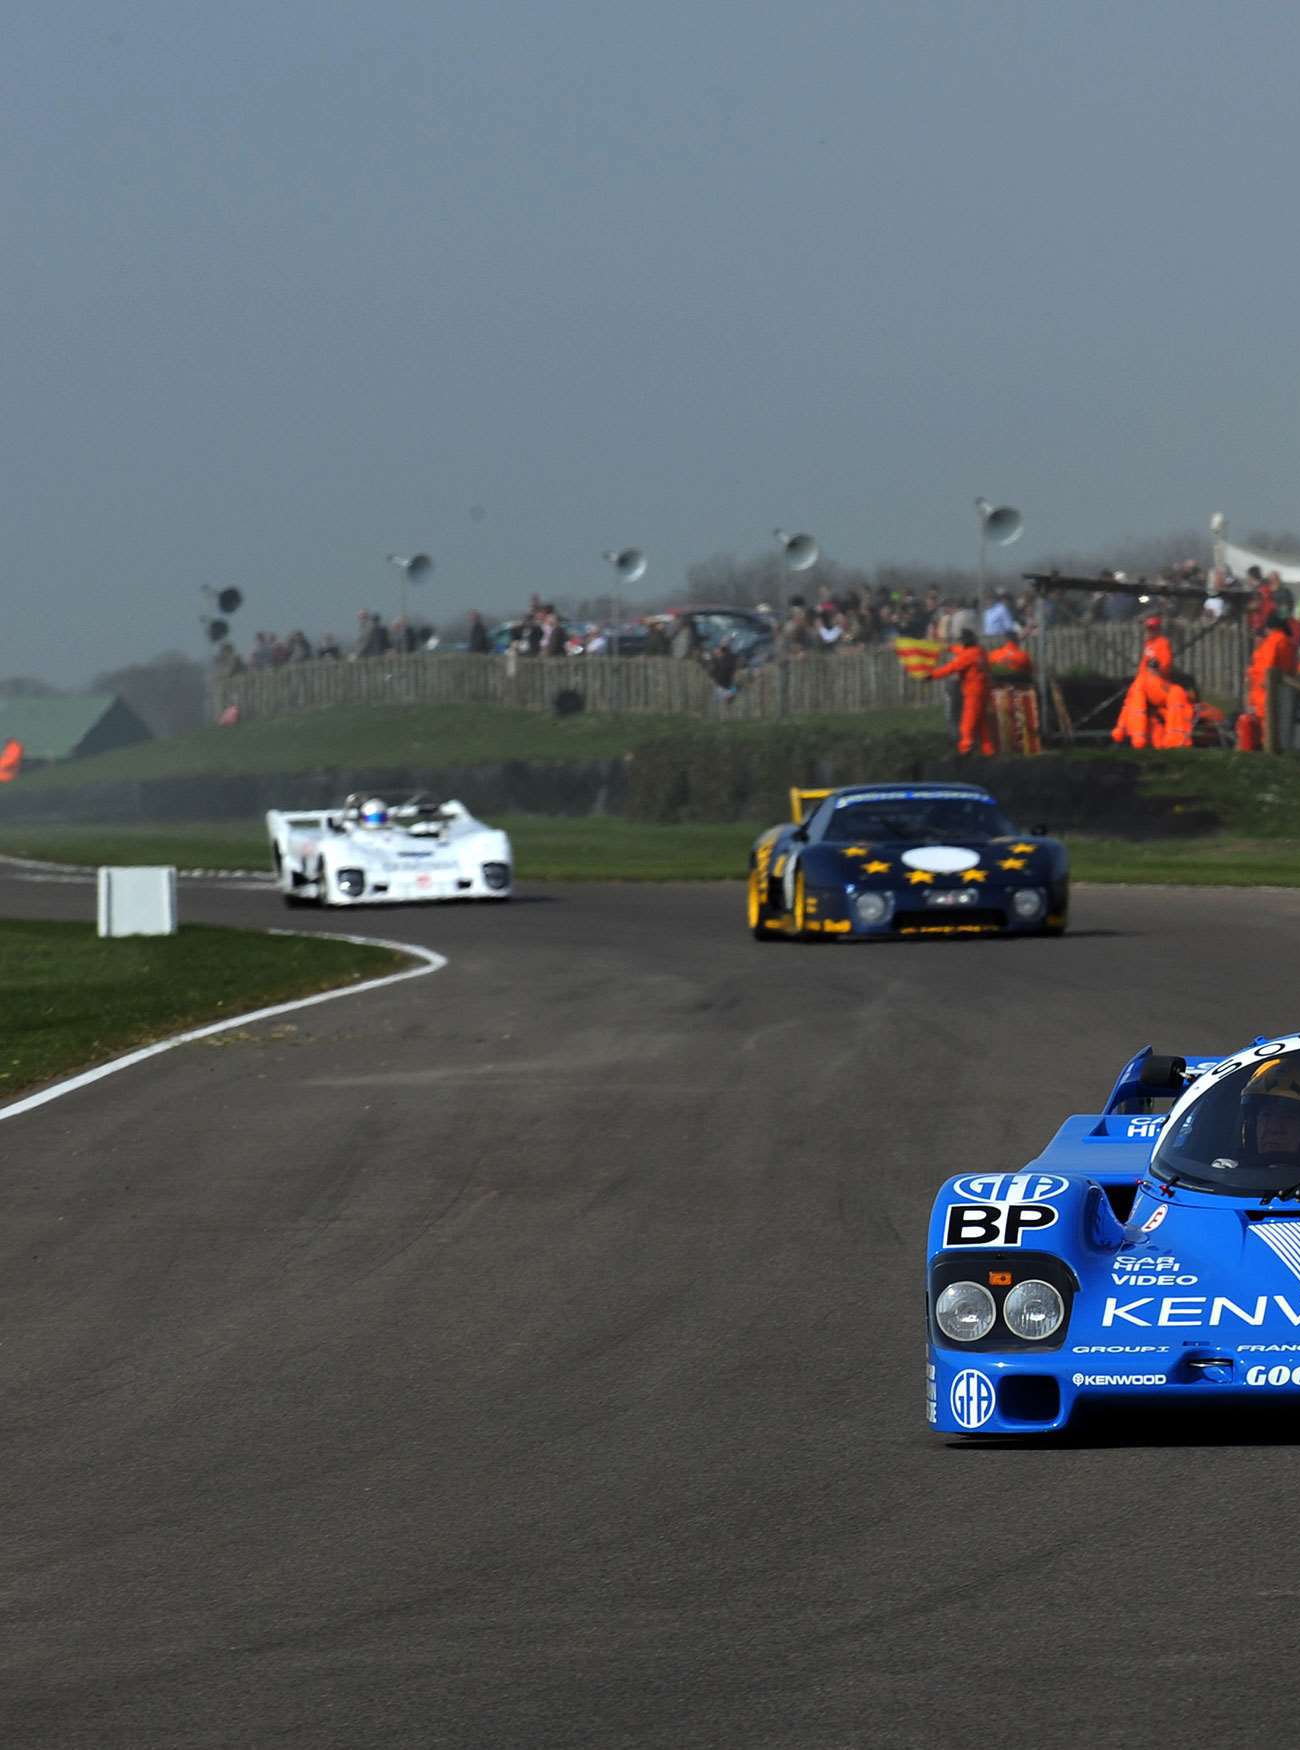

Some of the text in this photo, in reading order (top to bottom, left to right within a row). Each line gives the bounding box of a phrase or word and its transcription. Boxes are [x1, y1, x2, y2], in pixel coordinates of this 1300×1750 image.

[1130, 1117, 1168, 1125] CA
[946, 1205, 1056, 1246] BP
[1115, 1256, 1176, 1265] CAR
[1112, 1263, 1180, 1272] HI-FI
[1111, 1273, 1199, 1286] VIDEO
[1084, 1374, 1167, 1385] KENWOOD
[951, 1369, 995, 1428] GFA
